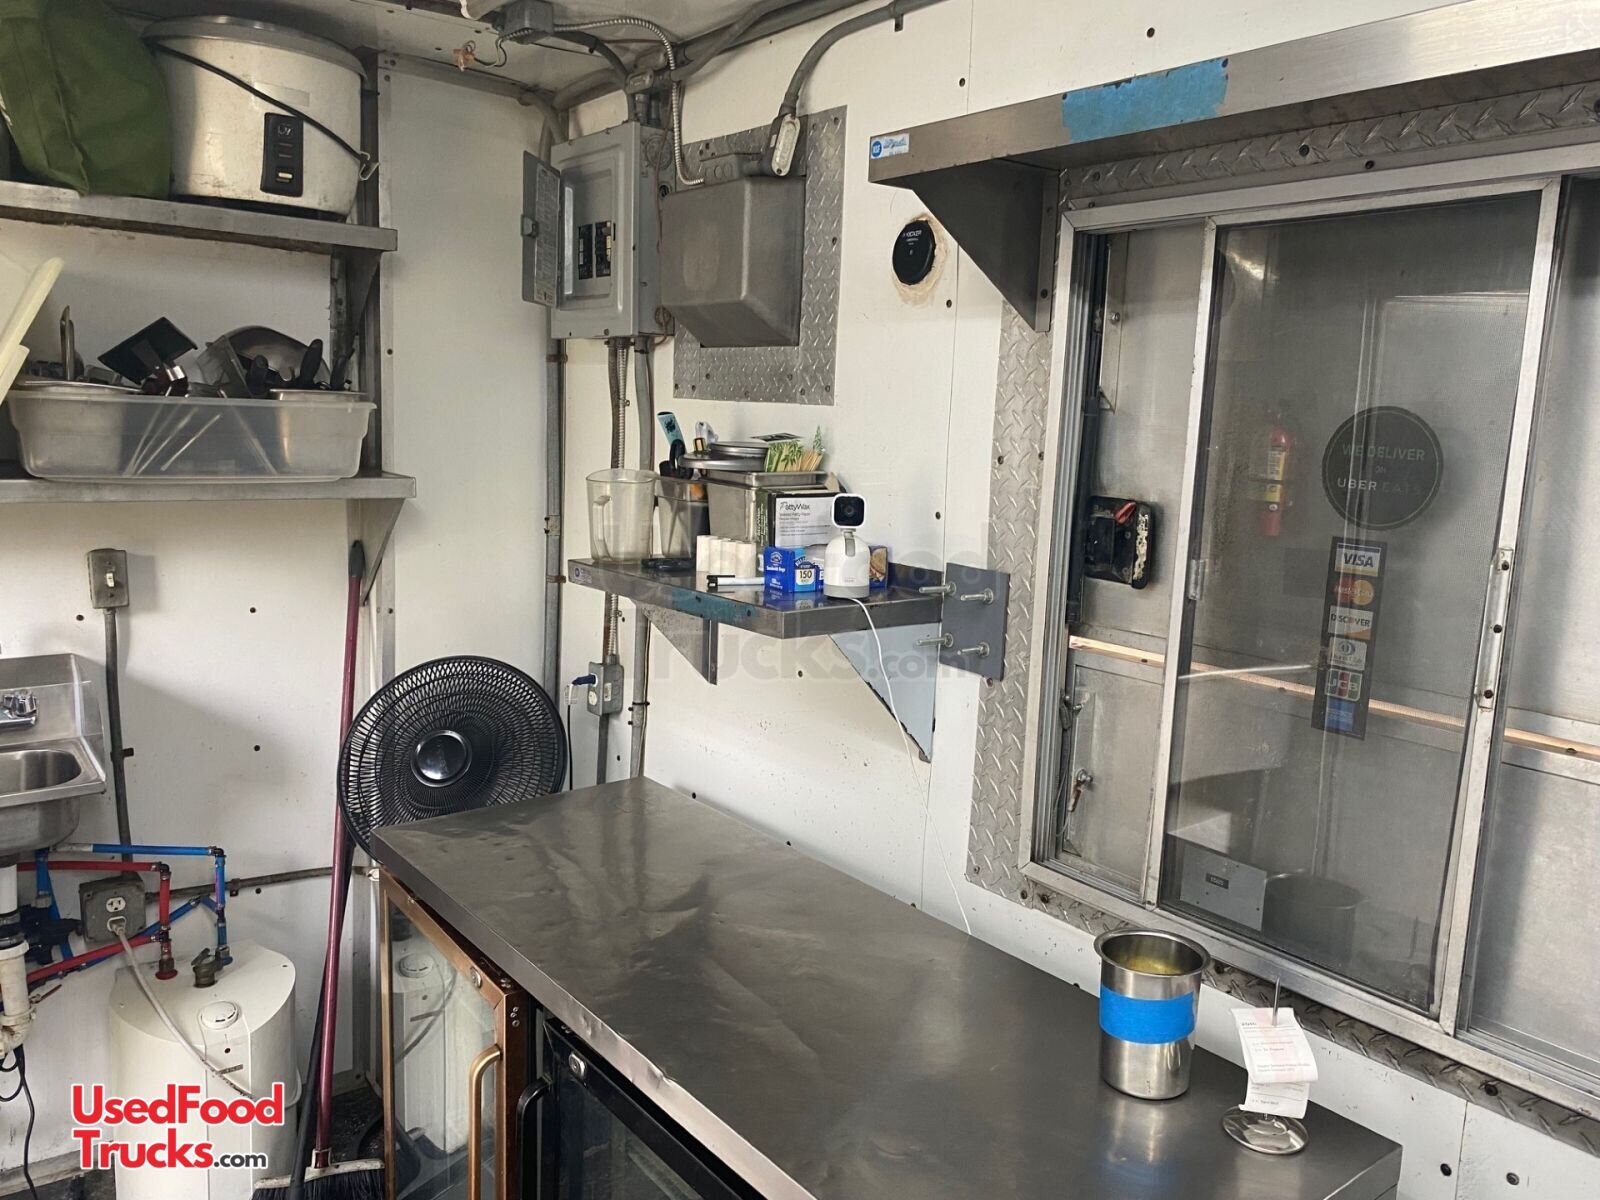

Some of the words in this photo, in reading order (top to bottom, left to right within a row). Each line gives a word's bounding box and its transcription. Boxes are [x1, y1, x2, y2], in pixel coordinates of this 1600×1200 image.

[1343, 443, 1363, 457] WE
[1367, 446, 1425, 461] DELIVER
[1337, 478, 1377, 491] UBER
[1343, 553, 1374, 568] VISA
[800, 570, 813, 579] 150
[1330, 613, 1370, 627] DSCOVER
